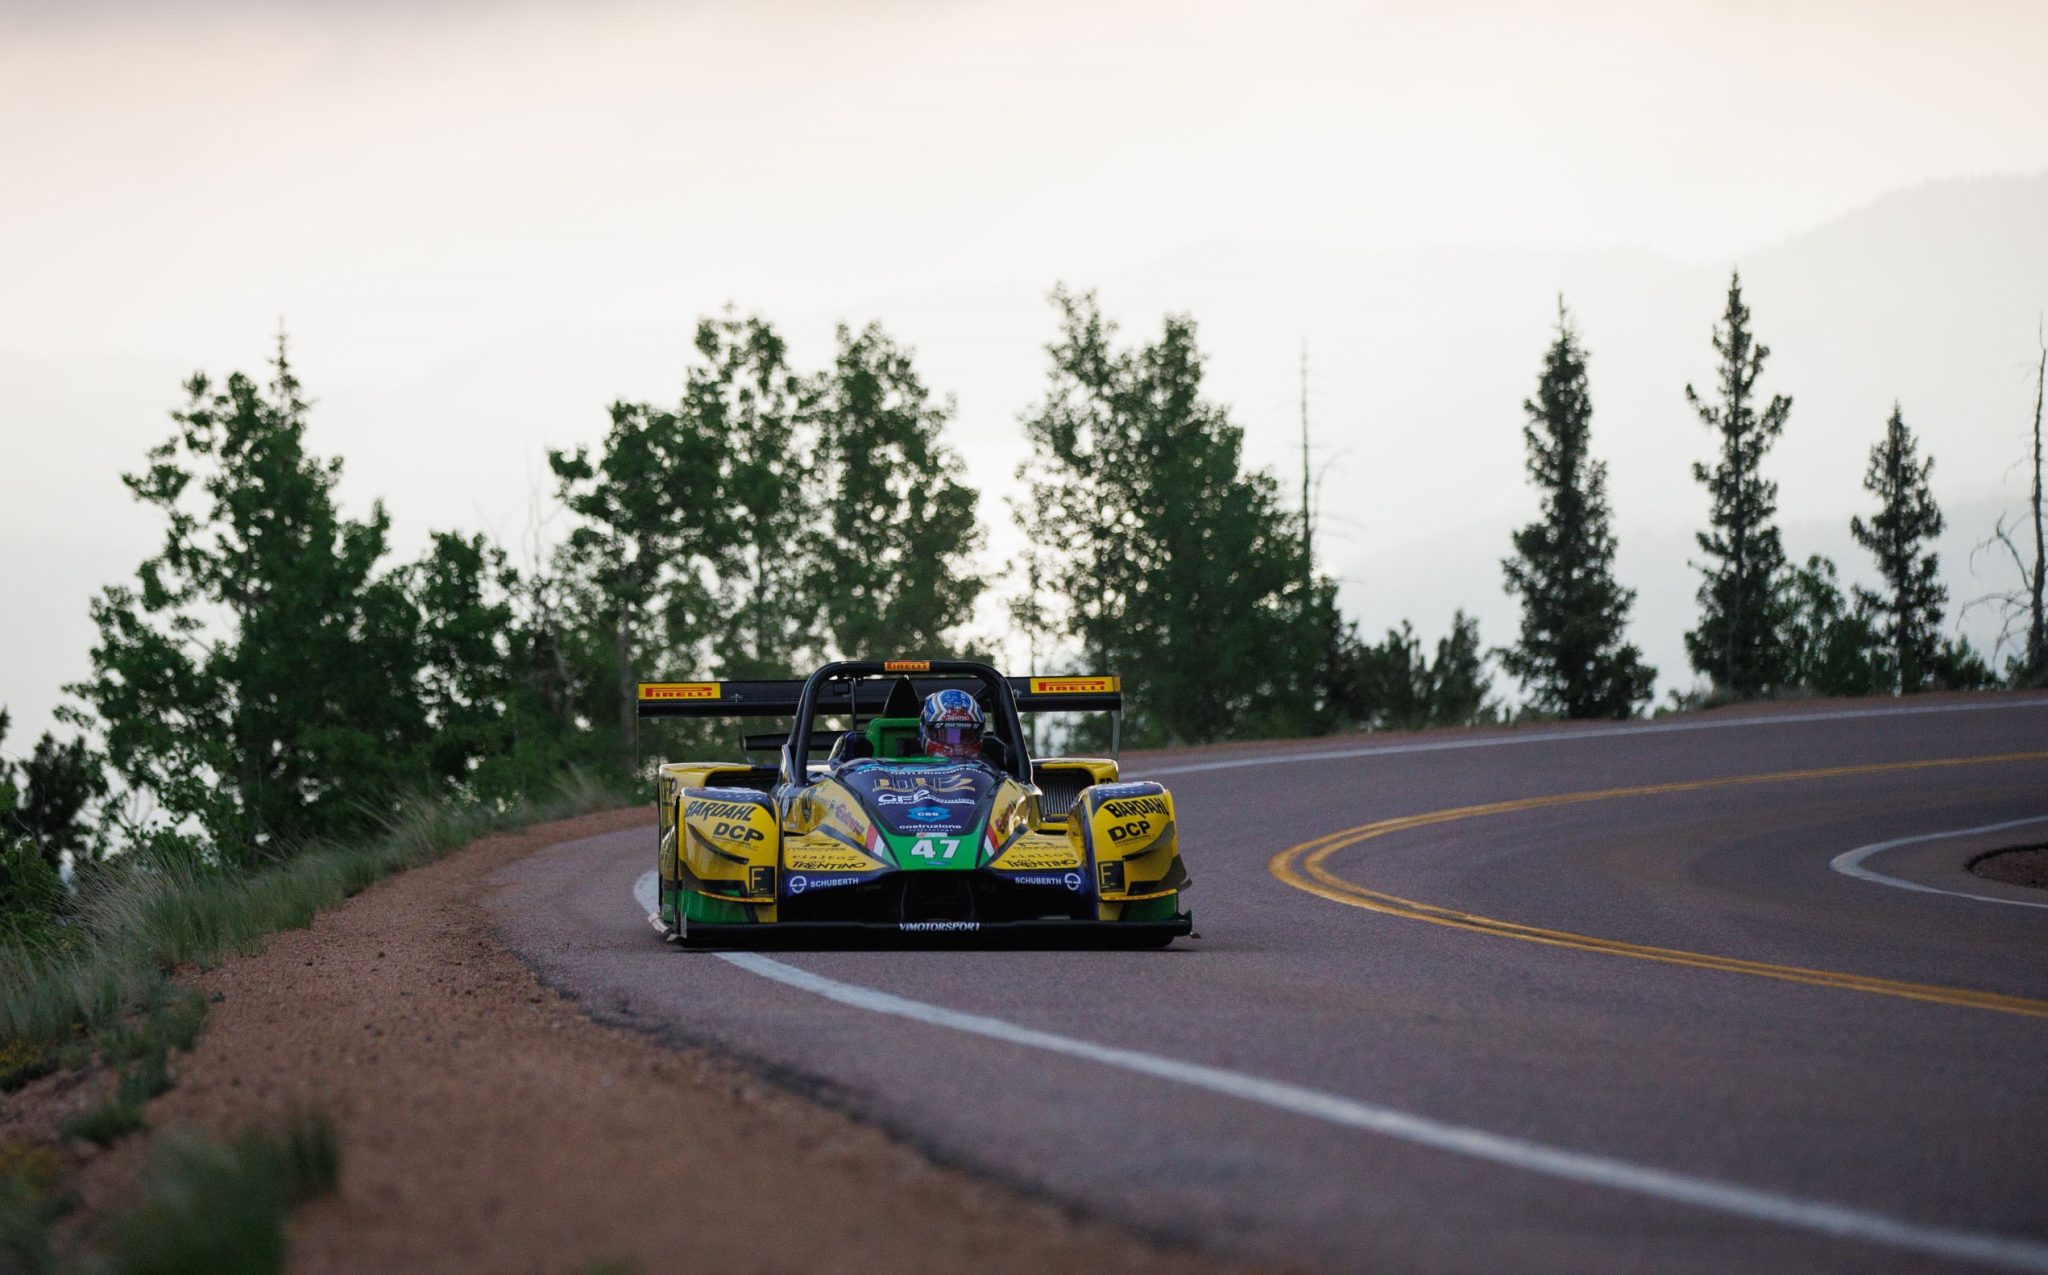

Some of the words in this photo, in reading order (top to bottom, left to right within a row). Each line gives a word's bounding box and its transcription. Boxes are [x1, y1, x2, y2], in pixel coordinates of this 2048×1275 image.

[645, 687, 712, 697] PIRELLI
[1039, 681, 1105, 691] PIRELLI
[686, 801, 756, 822] BARDAHL
[1104, 798, 1169, 819] BARDAHL
[712, 822, 765, 841] DCP
[1107, 821, 1151, 841] DCP
[911, 839, 961, 859] 47
[792, 861, 867, 870] TRENTINO
[810, 878, 859, 888] SCHUBERTH
[1015, 876, 1062, 885] SCHUBERTH
